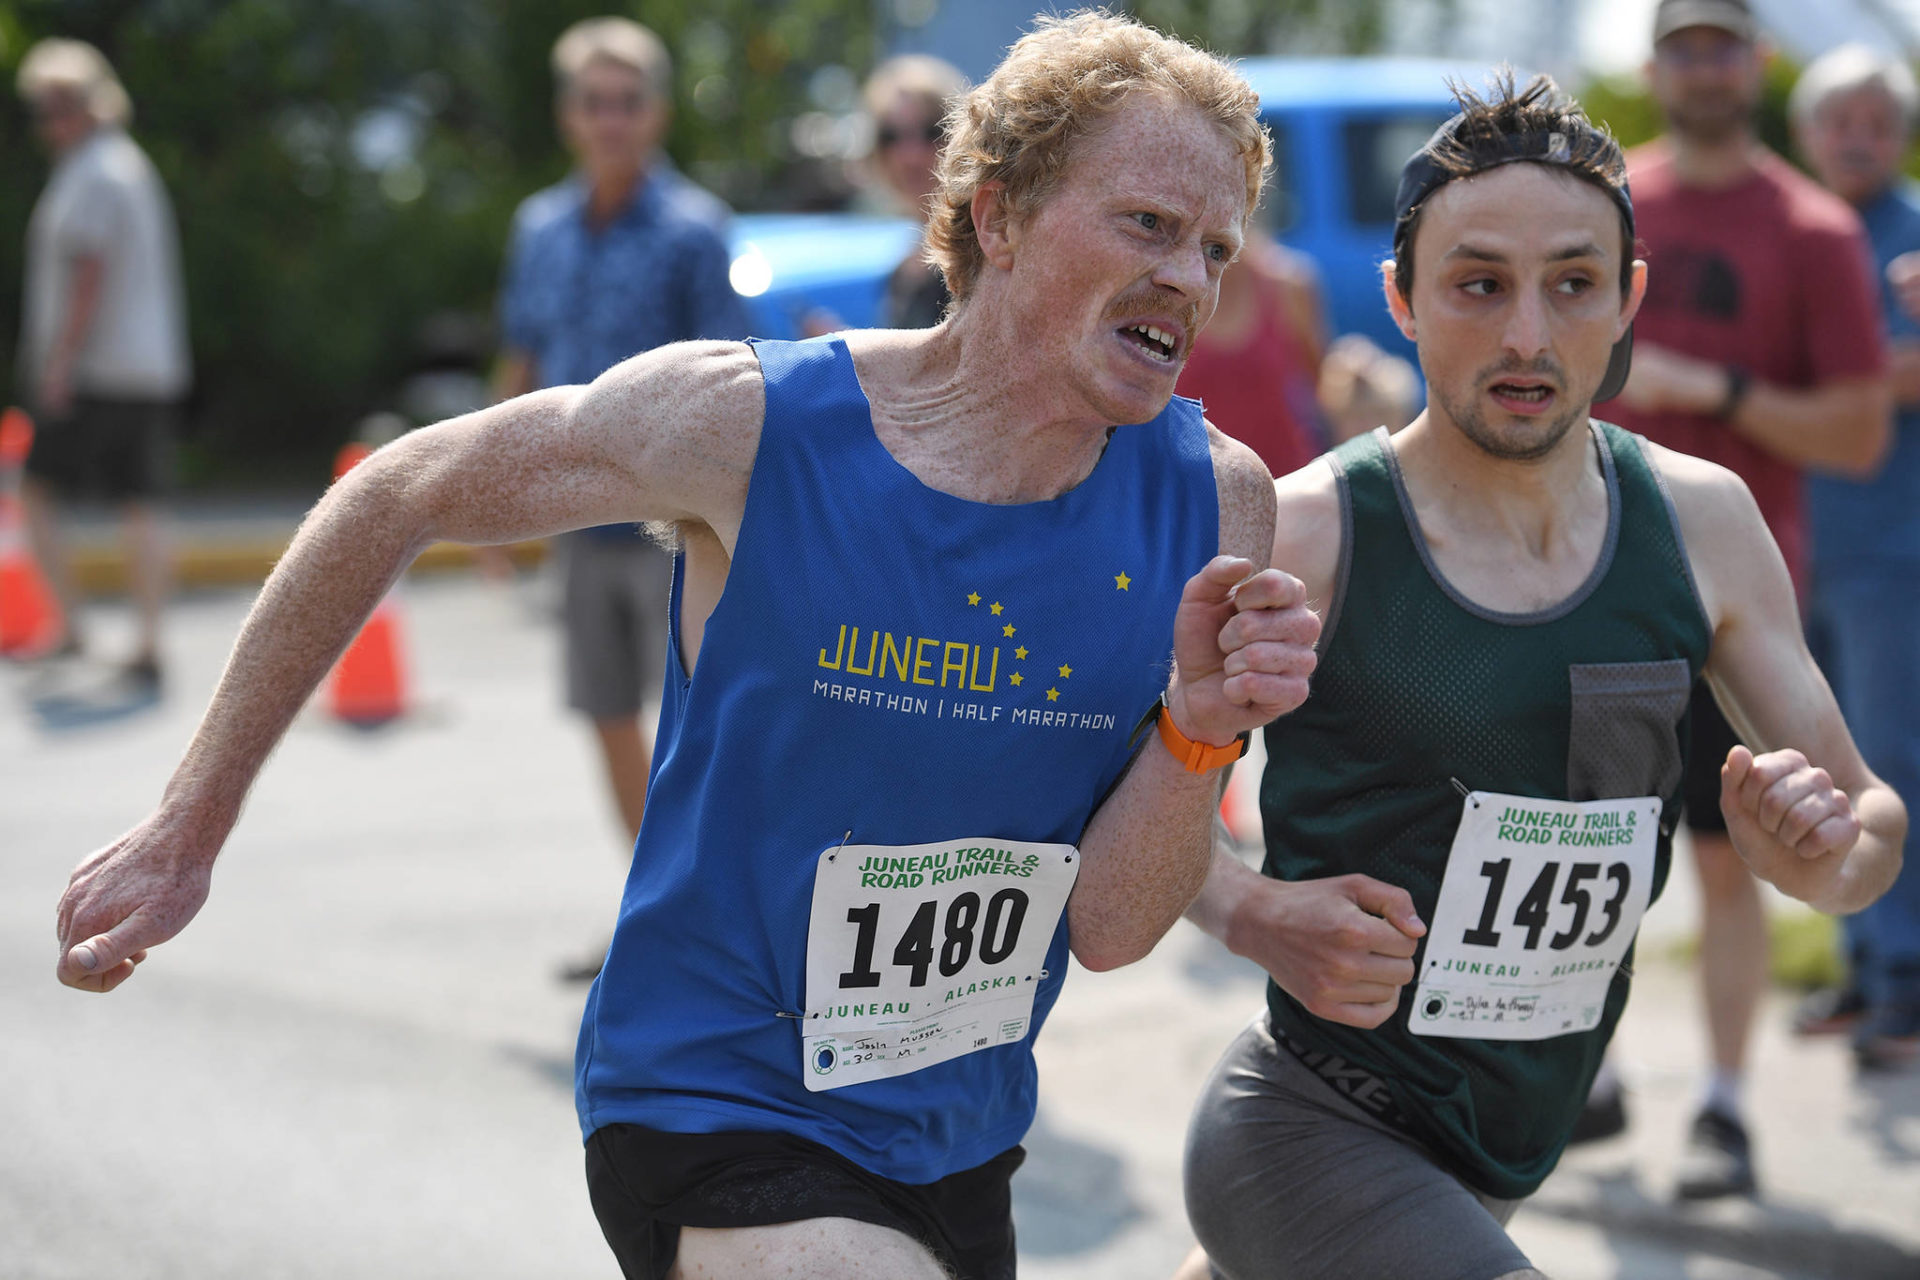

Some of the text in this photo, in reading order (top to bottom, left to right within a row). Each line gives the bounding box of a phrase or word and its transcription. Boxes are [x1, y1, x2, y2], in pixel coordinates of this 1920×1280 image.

[818, 624, 999, 692] JUNEAU
[813, 679, 928, 714] MARATHON
[952, 702, 1002, 722] HALF
[1012, 708, 1115, 730] MARATHON
[1498, 807, 1637, 829] JUNEAU TRAIL &
[1498, 824, 1634, 847] ROAD RUNNERS
[858, 847, 1040, 873] JUNEAU TRAIL &
[861, 861, 1034, 889] ROAD RUNNERS
[1462, 857, 1631, 950] 1453
[839, 888, 1029, 989] 1480
[1443, 959, 1605, 977] JUNEAU ALASKA
[825, 975, 1017, 1019] JUNEAU ALASKA
[854, 1053, 873, 1064] 30
